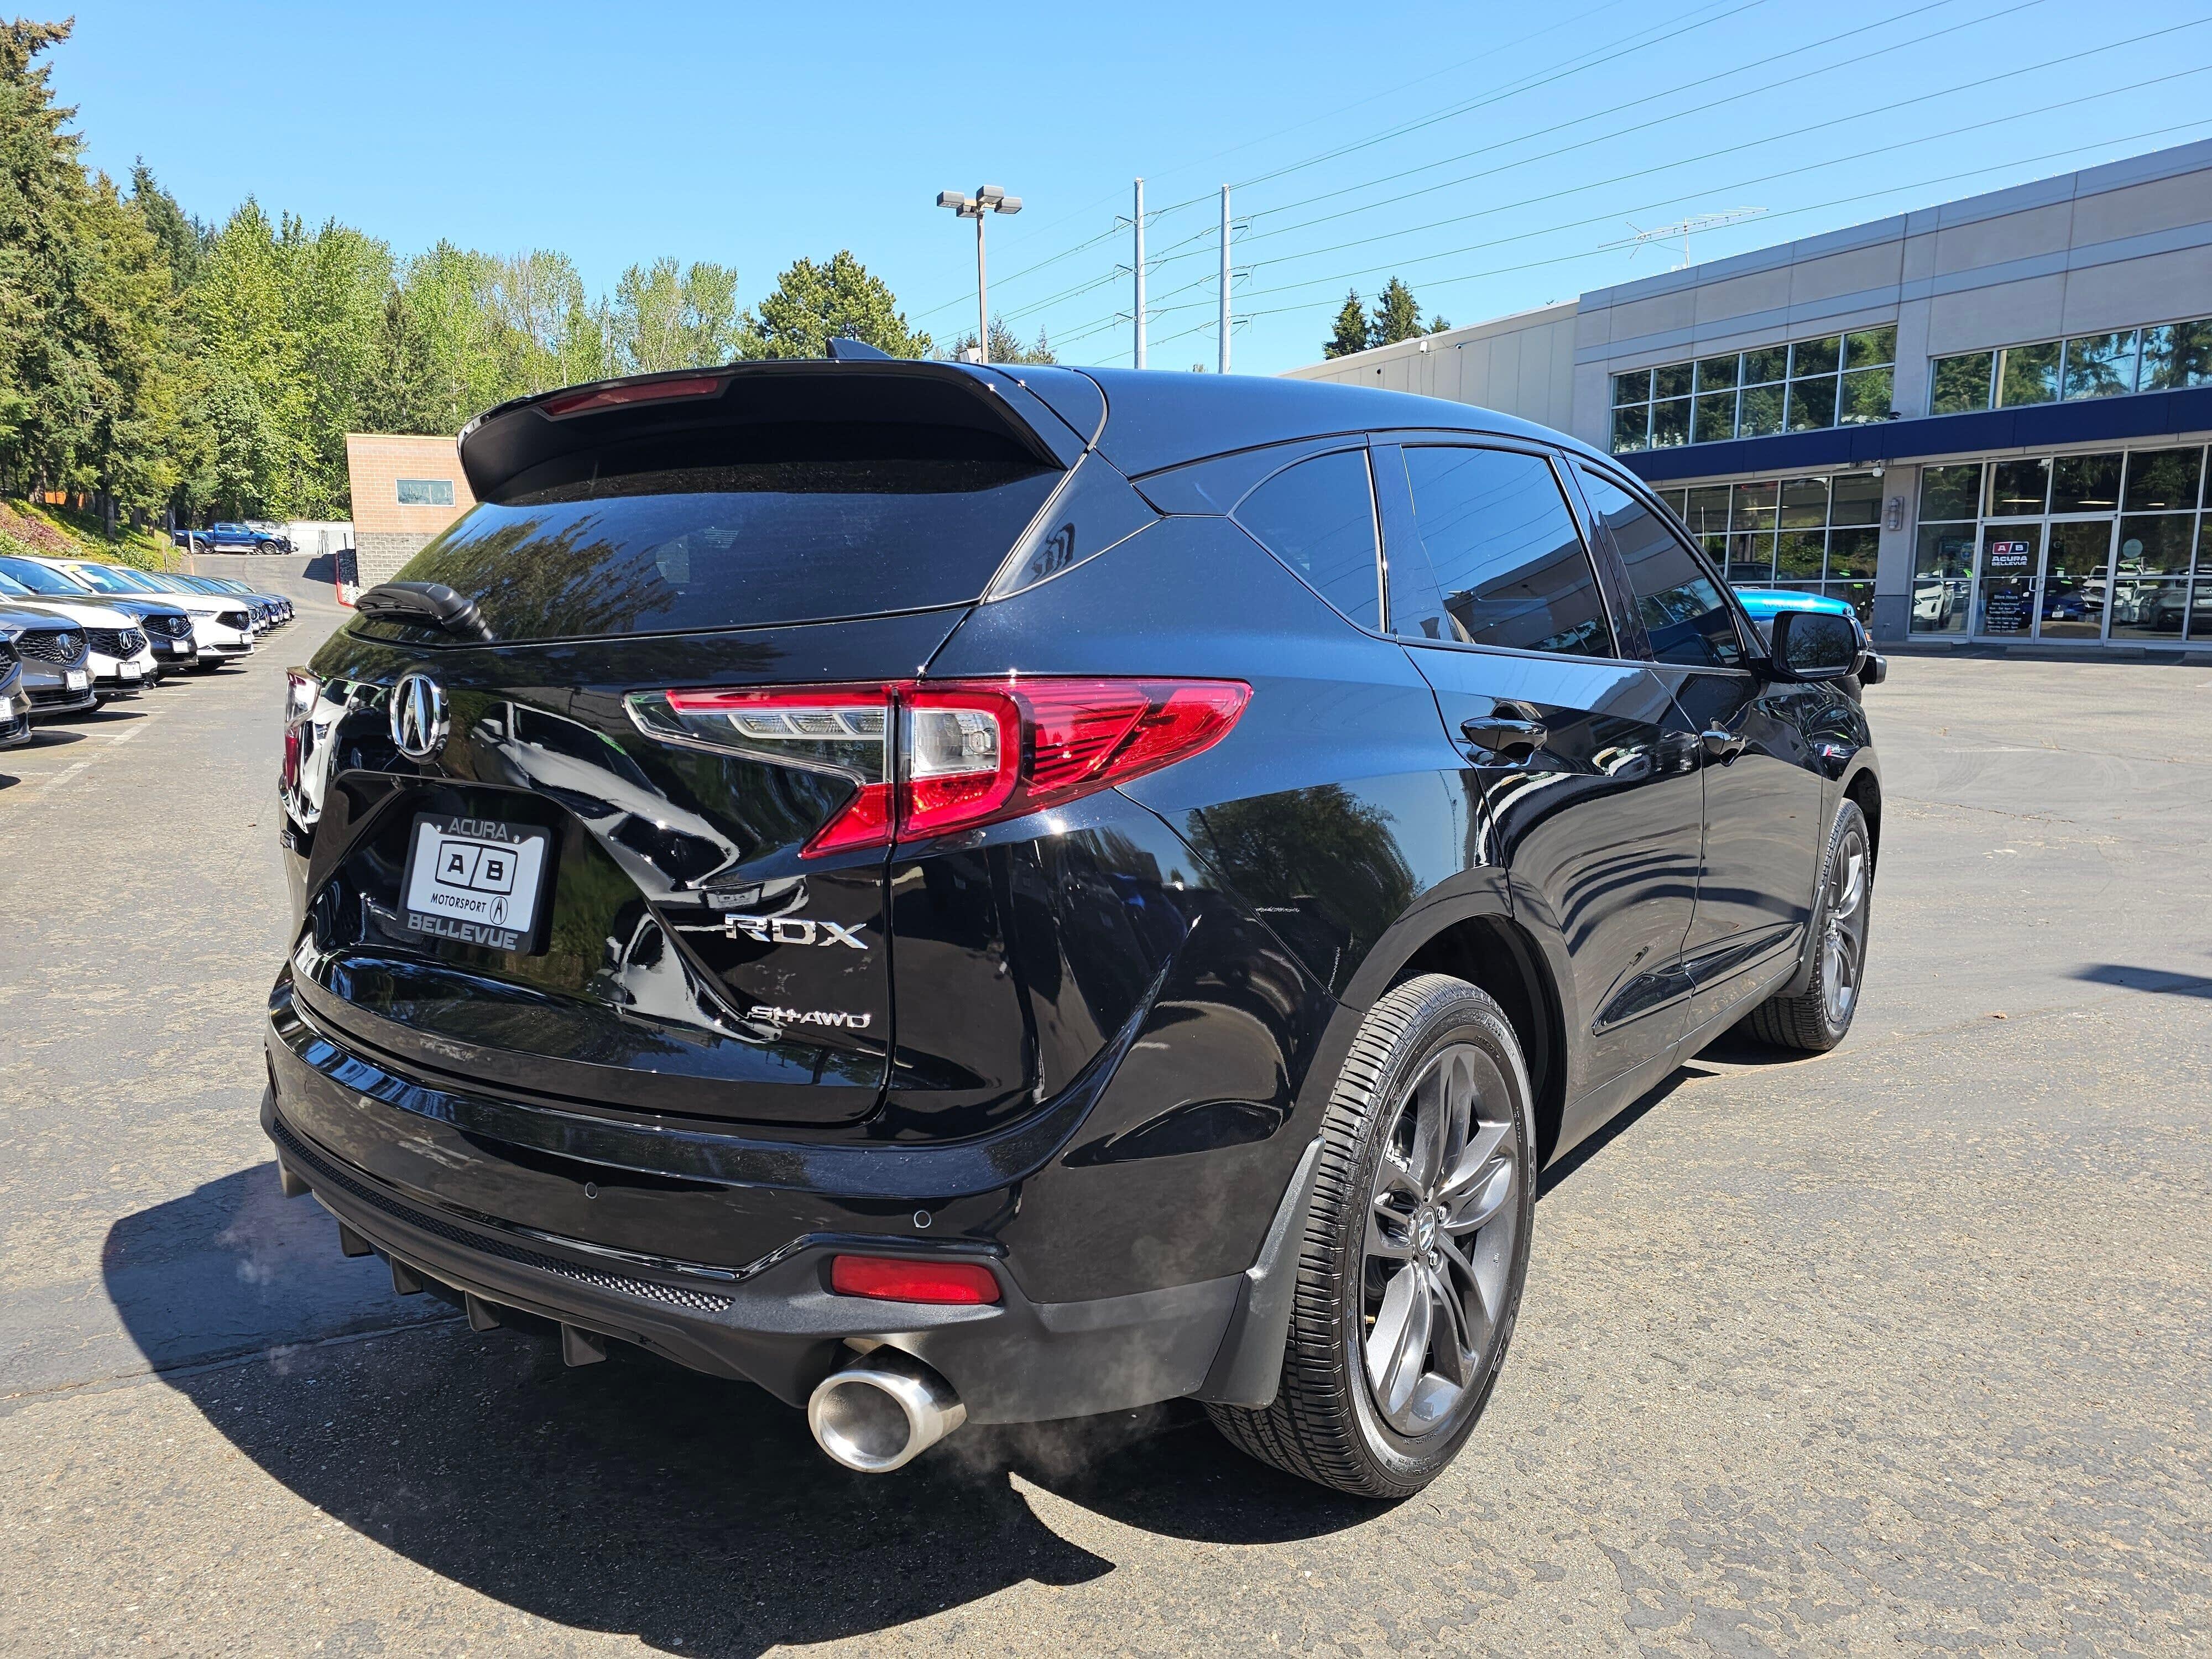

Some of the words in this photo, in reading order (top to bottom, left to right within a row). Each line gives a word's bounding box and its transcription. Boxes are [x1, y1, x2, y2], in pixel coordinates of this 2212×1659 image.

[447, 817, 508, 841] ACURA
[430, 893, 487, 913] MOTORSPORT
[407, 913, 518, 951] BELLEVUE
[725, 914, 869, 950] RDX
[751, 1005, 871, 1029] SH-AWD
